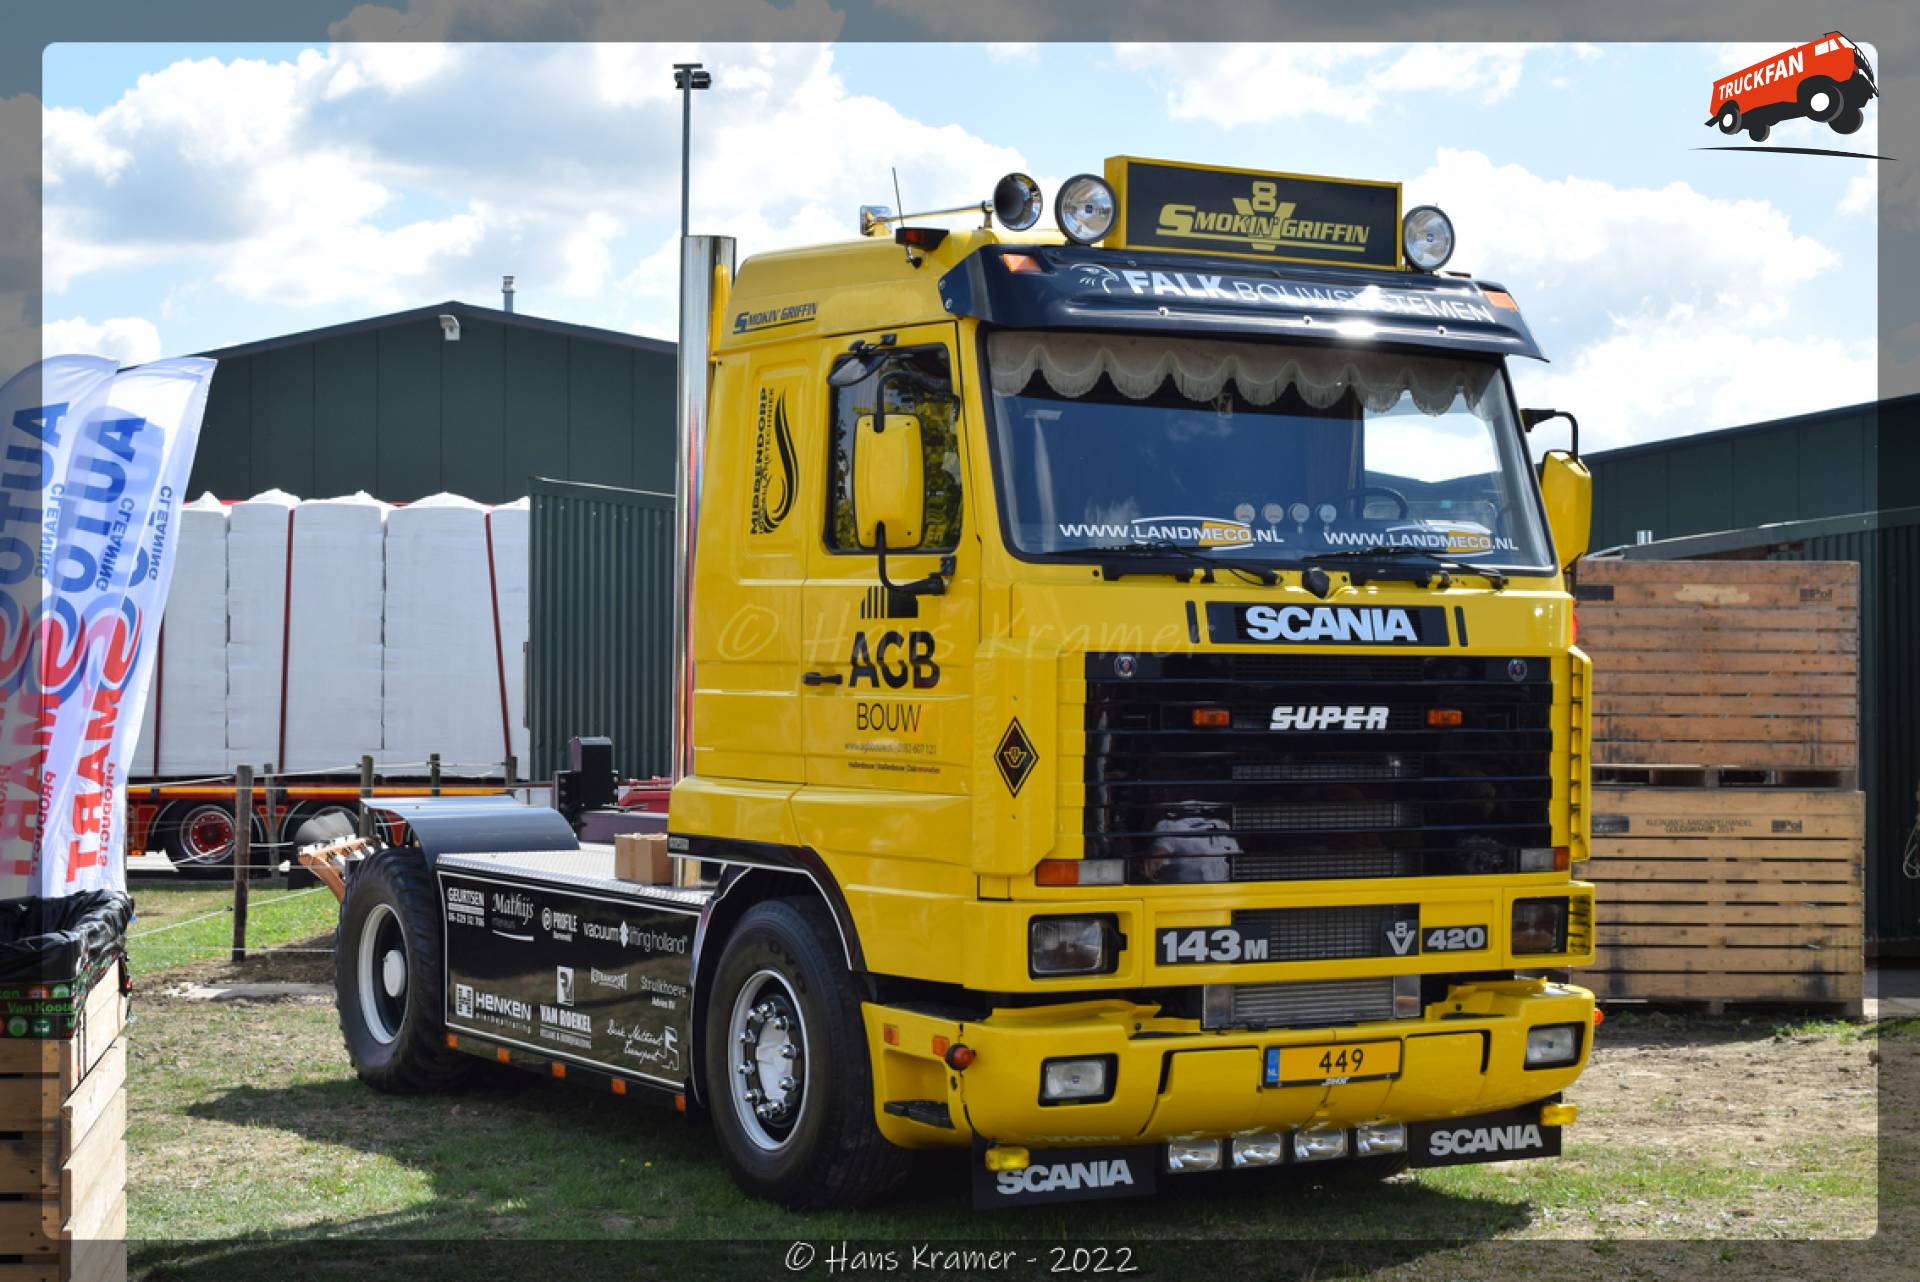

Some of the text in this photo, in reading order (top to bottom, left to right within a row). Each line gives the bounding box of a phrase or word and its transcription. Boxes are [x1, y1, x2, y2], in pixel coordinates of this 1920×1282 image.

[1281, 219, 1370, 244] GRIFFIN
[1121, 269, 1496, 323] FALK BOUWSSTEMEN
[780, 302, 817, 321] GRIFFIN
[750, 387, 768, 535] MIDDENDORP
[1245, 605, 1418, 641] SCANIA
[856, 702, 922, 733] BOUW
[1269, 705, 1390, 731] SUPER
[583, 922, 619, 942] vacuum
[1427, 927, 1486, 951] 420
[1319, 1047, 1364, 1074] 449
[1429, 1123, 1544, 1158] SCANIA
[996, 1159, 1134, 1196] SCANIA
